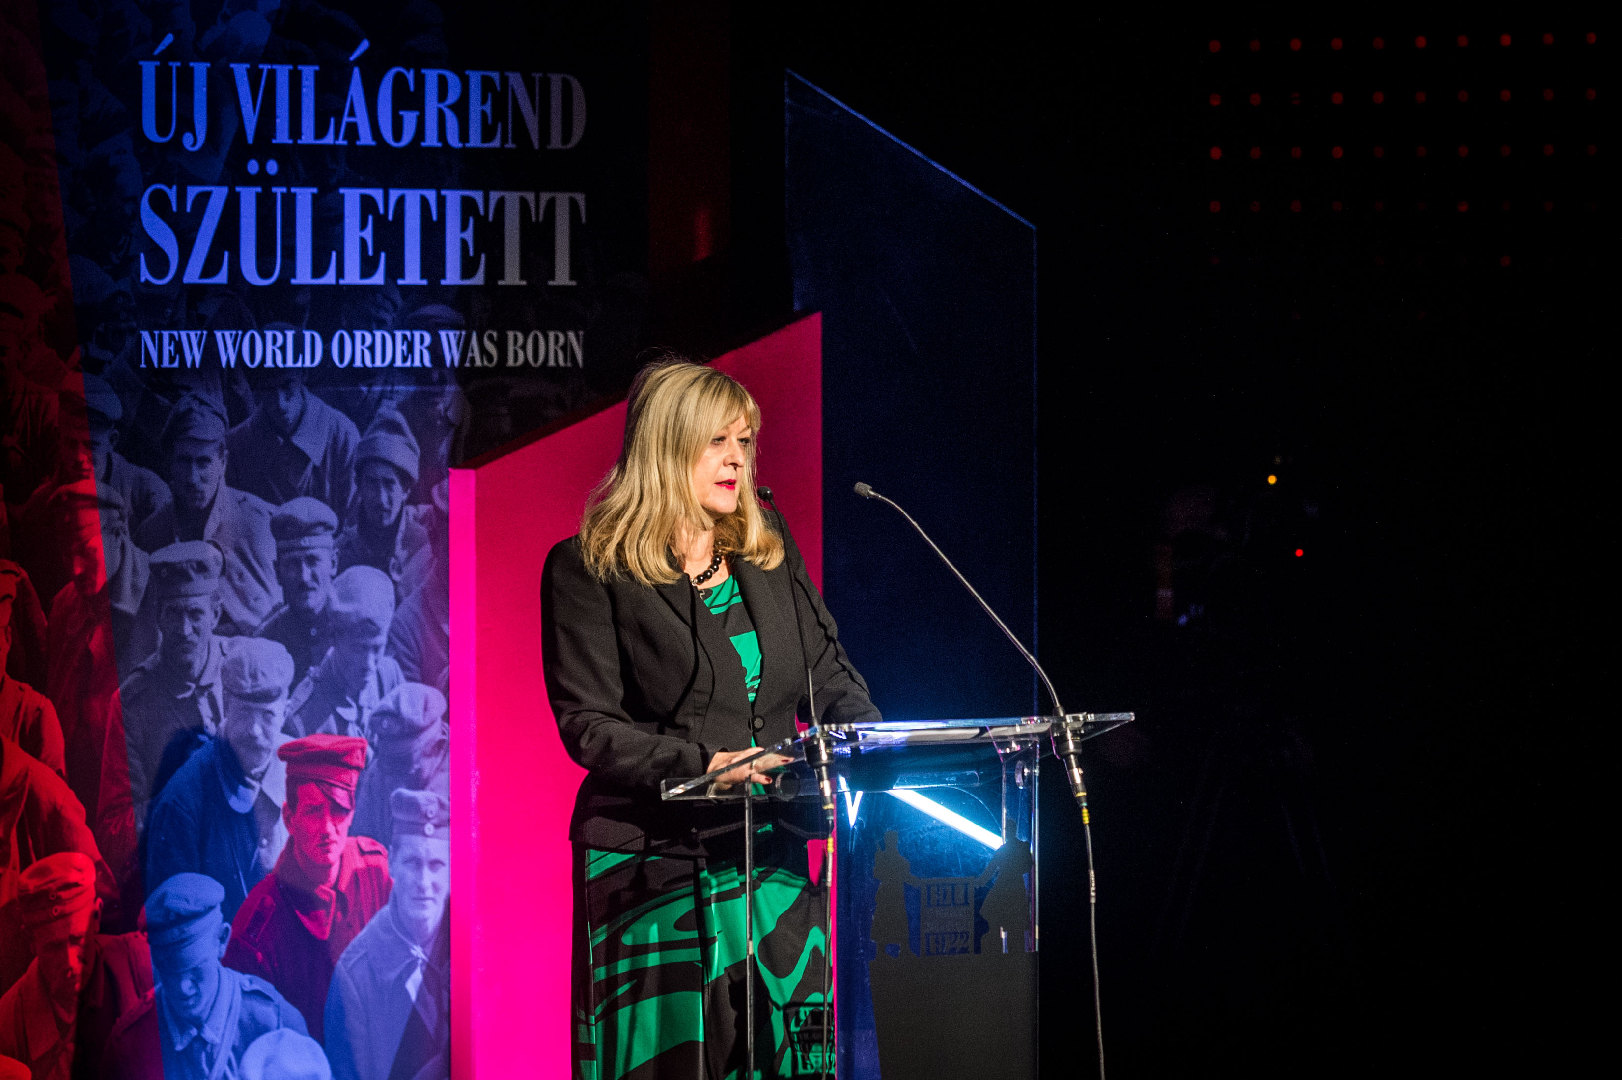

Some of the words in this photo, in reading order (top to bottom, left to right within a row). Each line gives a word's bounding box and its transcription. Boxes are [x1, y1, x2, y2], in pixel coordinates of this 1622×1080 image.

[138, 33, 211, 152] ÚJ
[229, 38, 588, 150] VILÁGREND
[139, 159, 587, 286] SZÜLETETT
[139, 329, 208, 369] NEW
[213, 329, 324, 369] WORLD
[330, 329, 433, 368] ORDER
[438, 329, 499, 368] WAS
[505, 329, 586, 368] BORN
